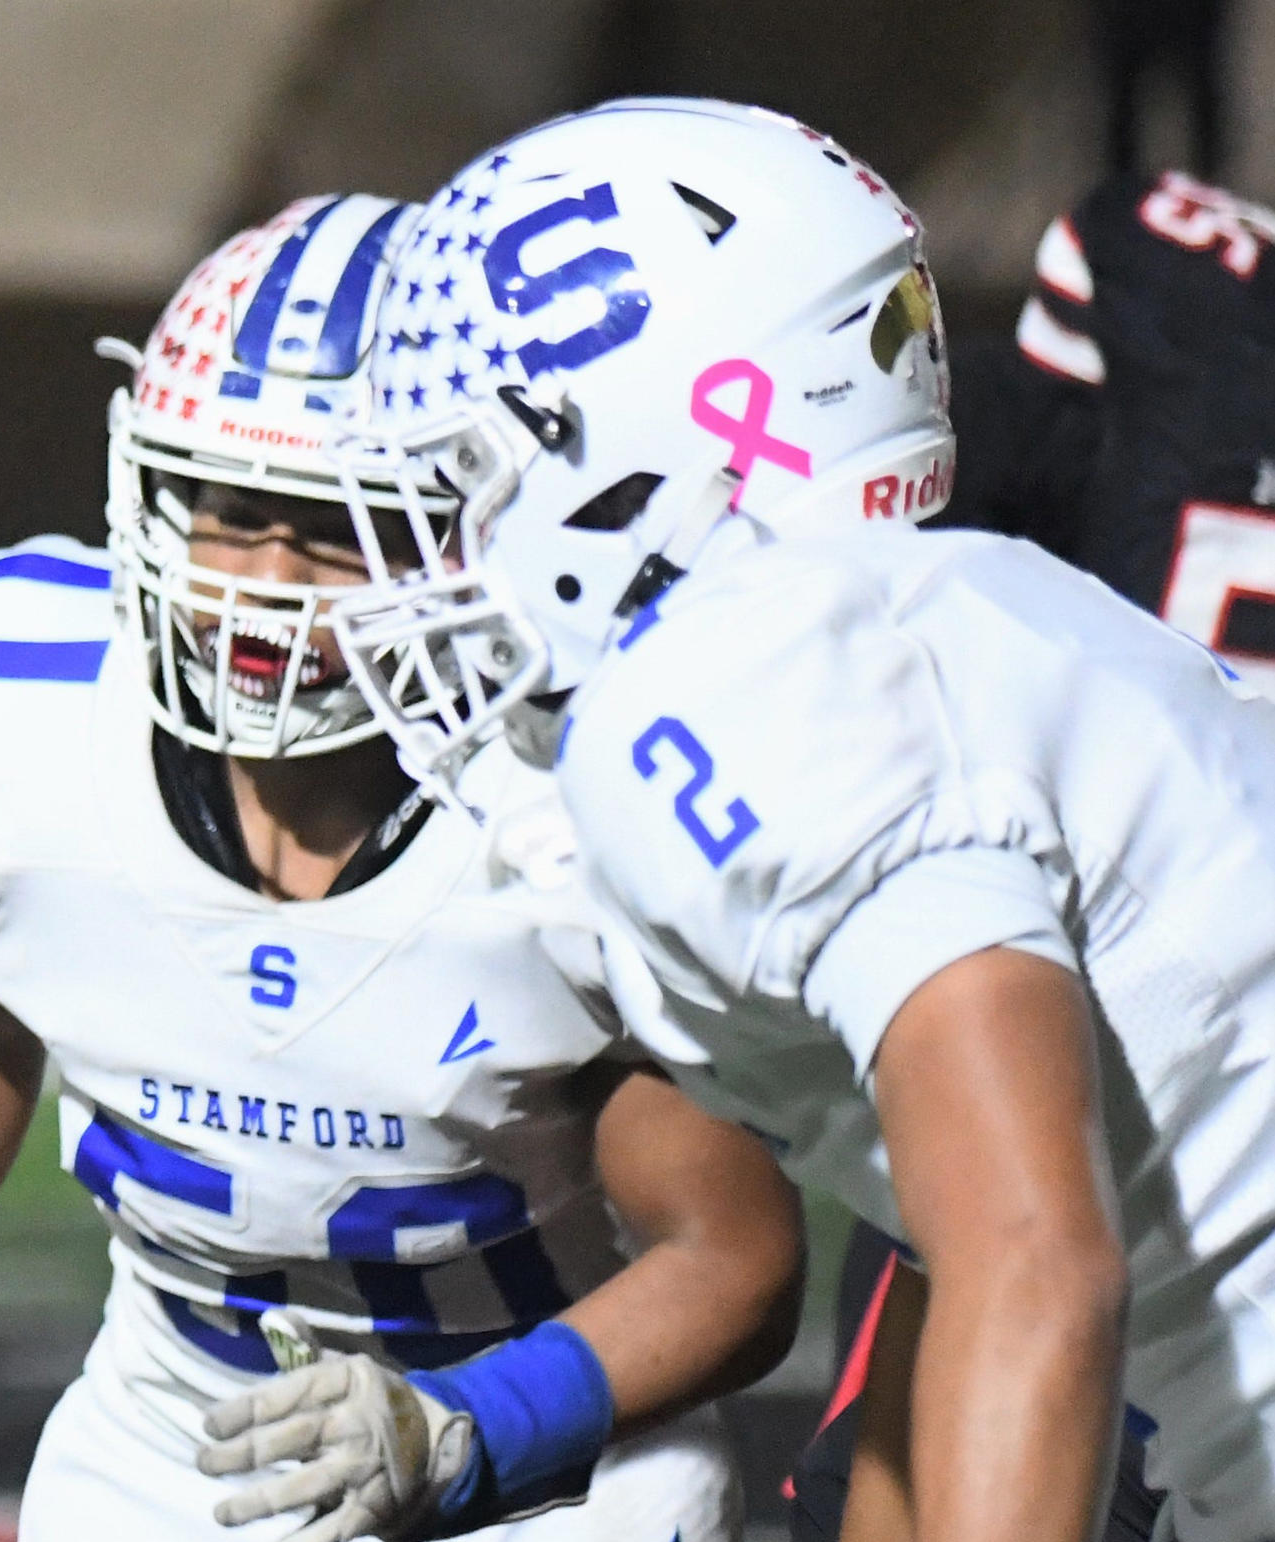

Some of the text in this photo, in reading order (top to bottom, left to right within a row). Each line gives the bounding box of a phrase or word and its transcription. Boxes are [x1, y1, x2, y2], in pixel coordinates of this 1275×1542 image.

[482, 182, 652, 383] S
[632, 715, 761, 868] 2
[249, 944, 297, 1010] S
[139, 1077, 405, 1151] STAMFORD
